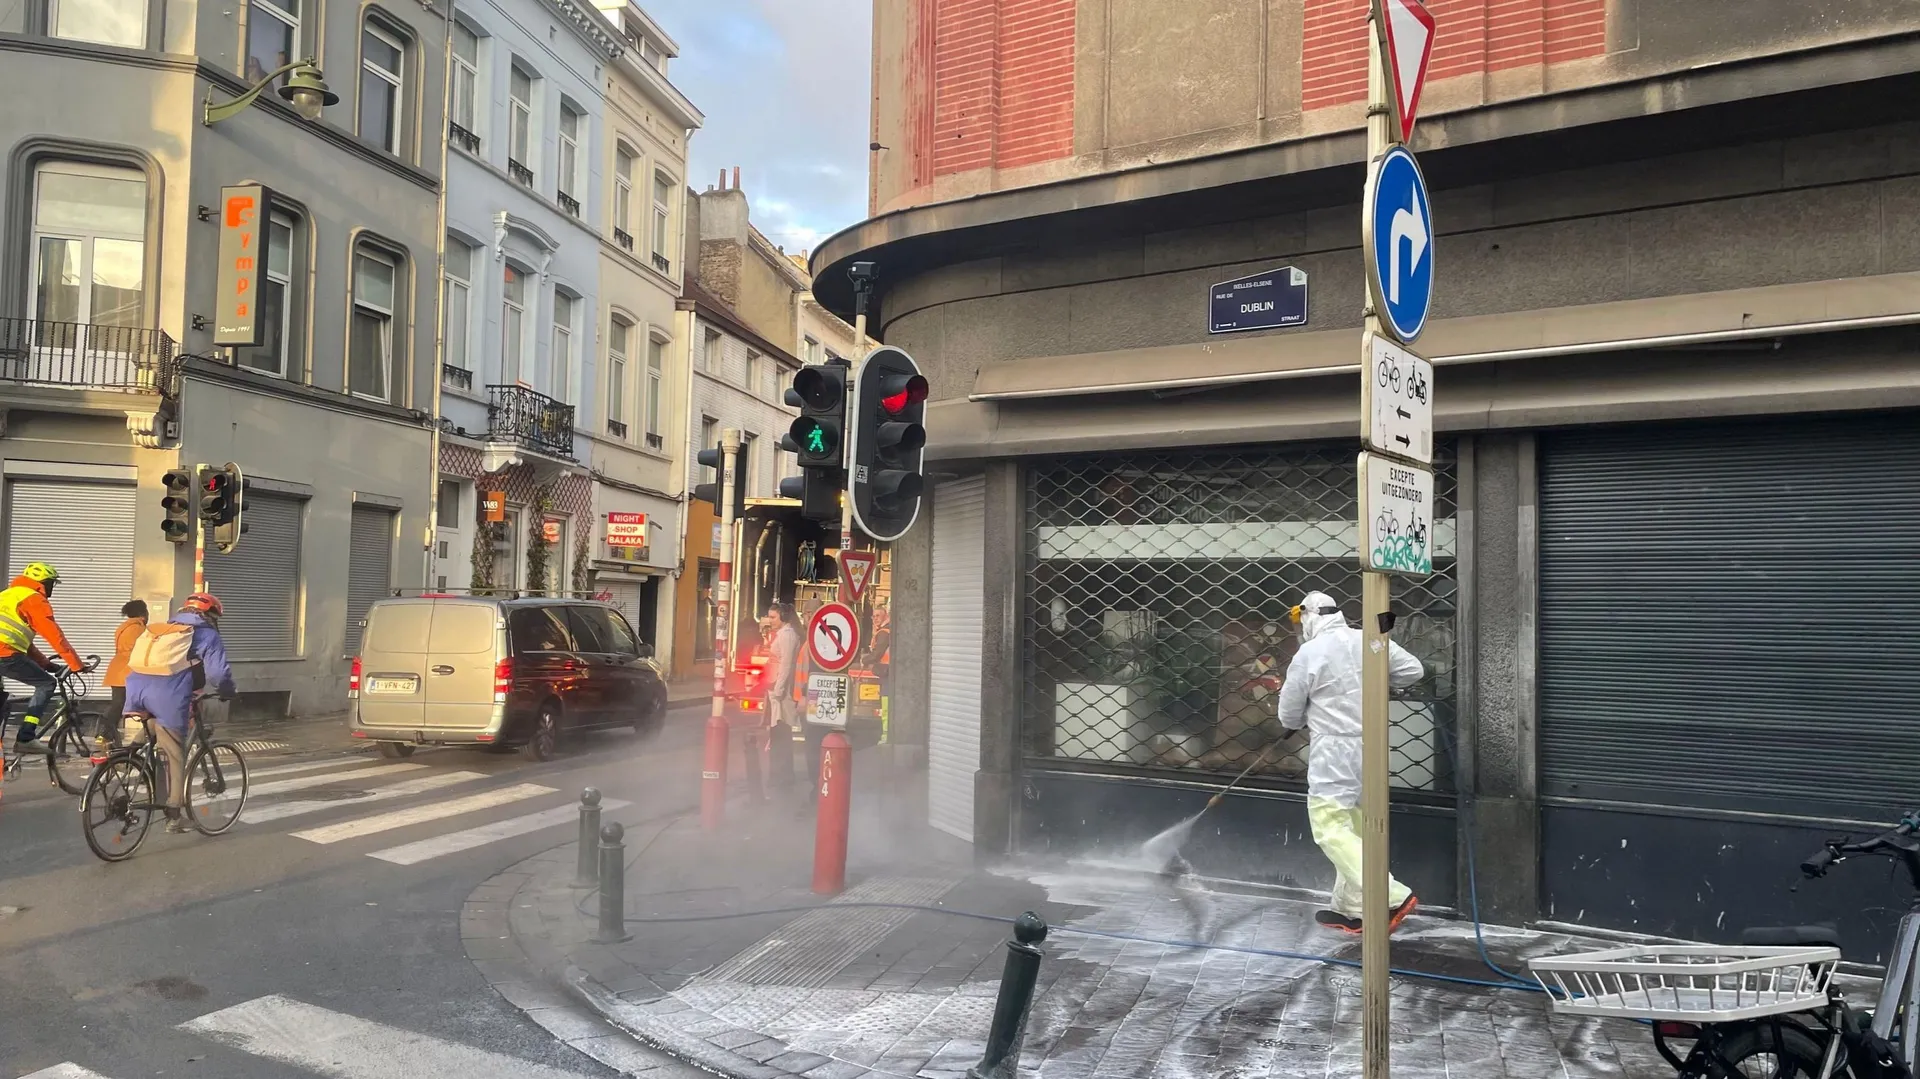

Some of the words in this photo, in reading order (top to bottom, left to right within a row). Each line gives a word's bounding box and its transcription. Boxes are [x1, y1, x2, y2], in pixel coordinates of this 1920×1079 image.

[1241, 301, 1274, 313] DUBLIN
[1390, 467, 1415, 485] EXCEPTE
[1382, 482, 1422, 503] UITGEZONDERD
[613, 514, 640, 522] NIGHT
[615, 525, 638, 533] SHOP
[608, 536, 642, 544] BALAKA
